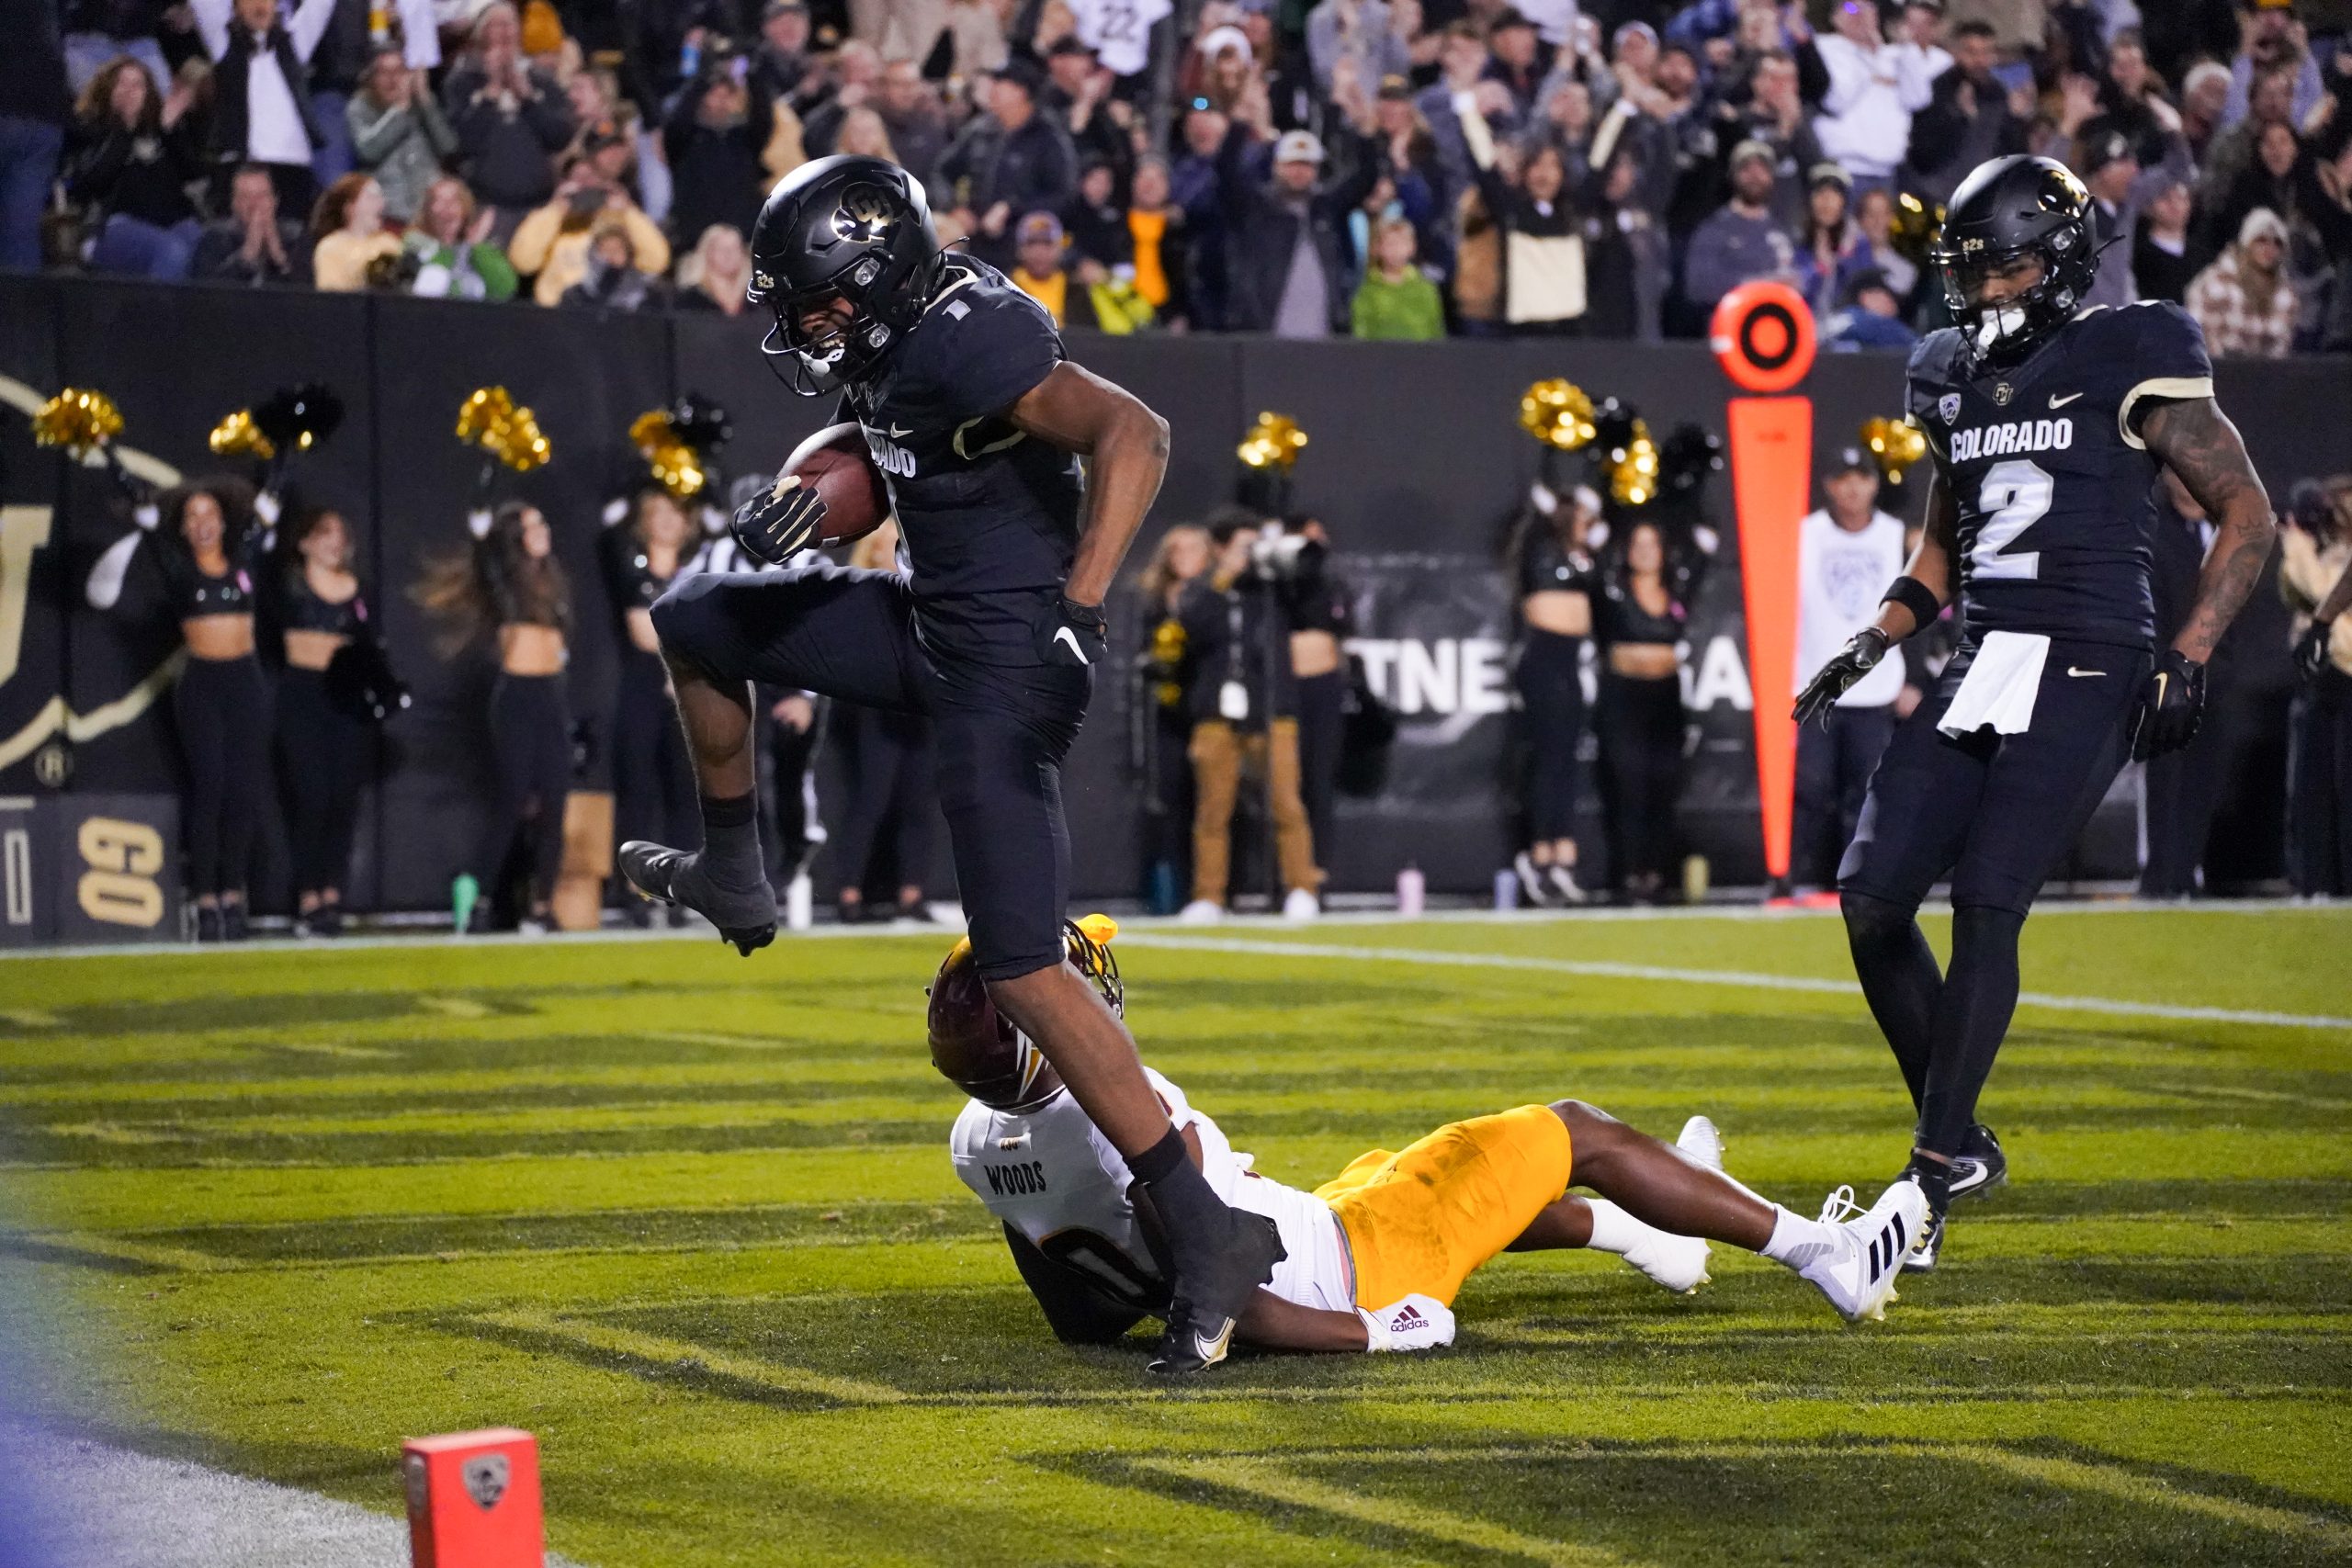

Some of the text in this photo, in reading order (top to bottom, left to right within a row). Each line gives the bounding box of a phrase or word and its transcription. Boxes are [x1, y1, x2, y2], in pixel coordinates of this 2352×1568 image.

[1950, 418, 2073, 464] COLORADO
[1971, 459, 2054, 580] 2
[983, 1162, 1046, 1195] WOODS
[1390, 1319, 1430, 1333] adidas
